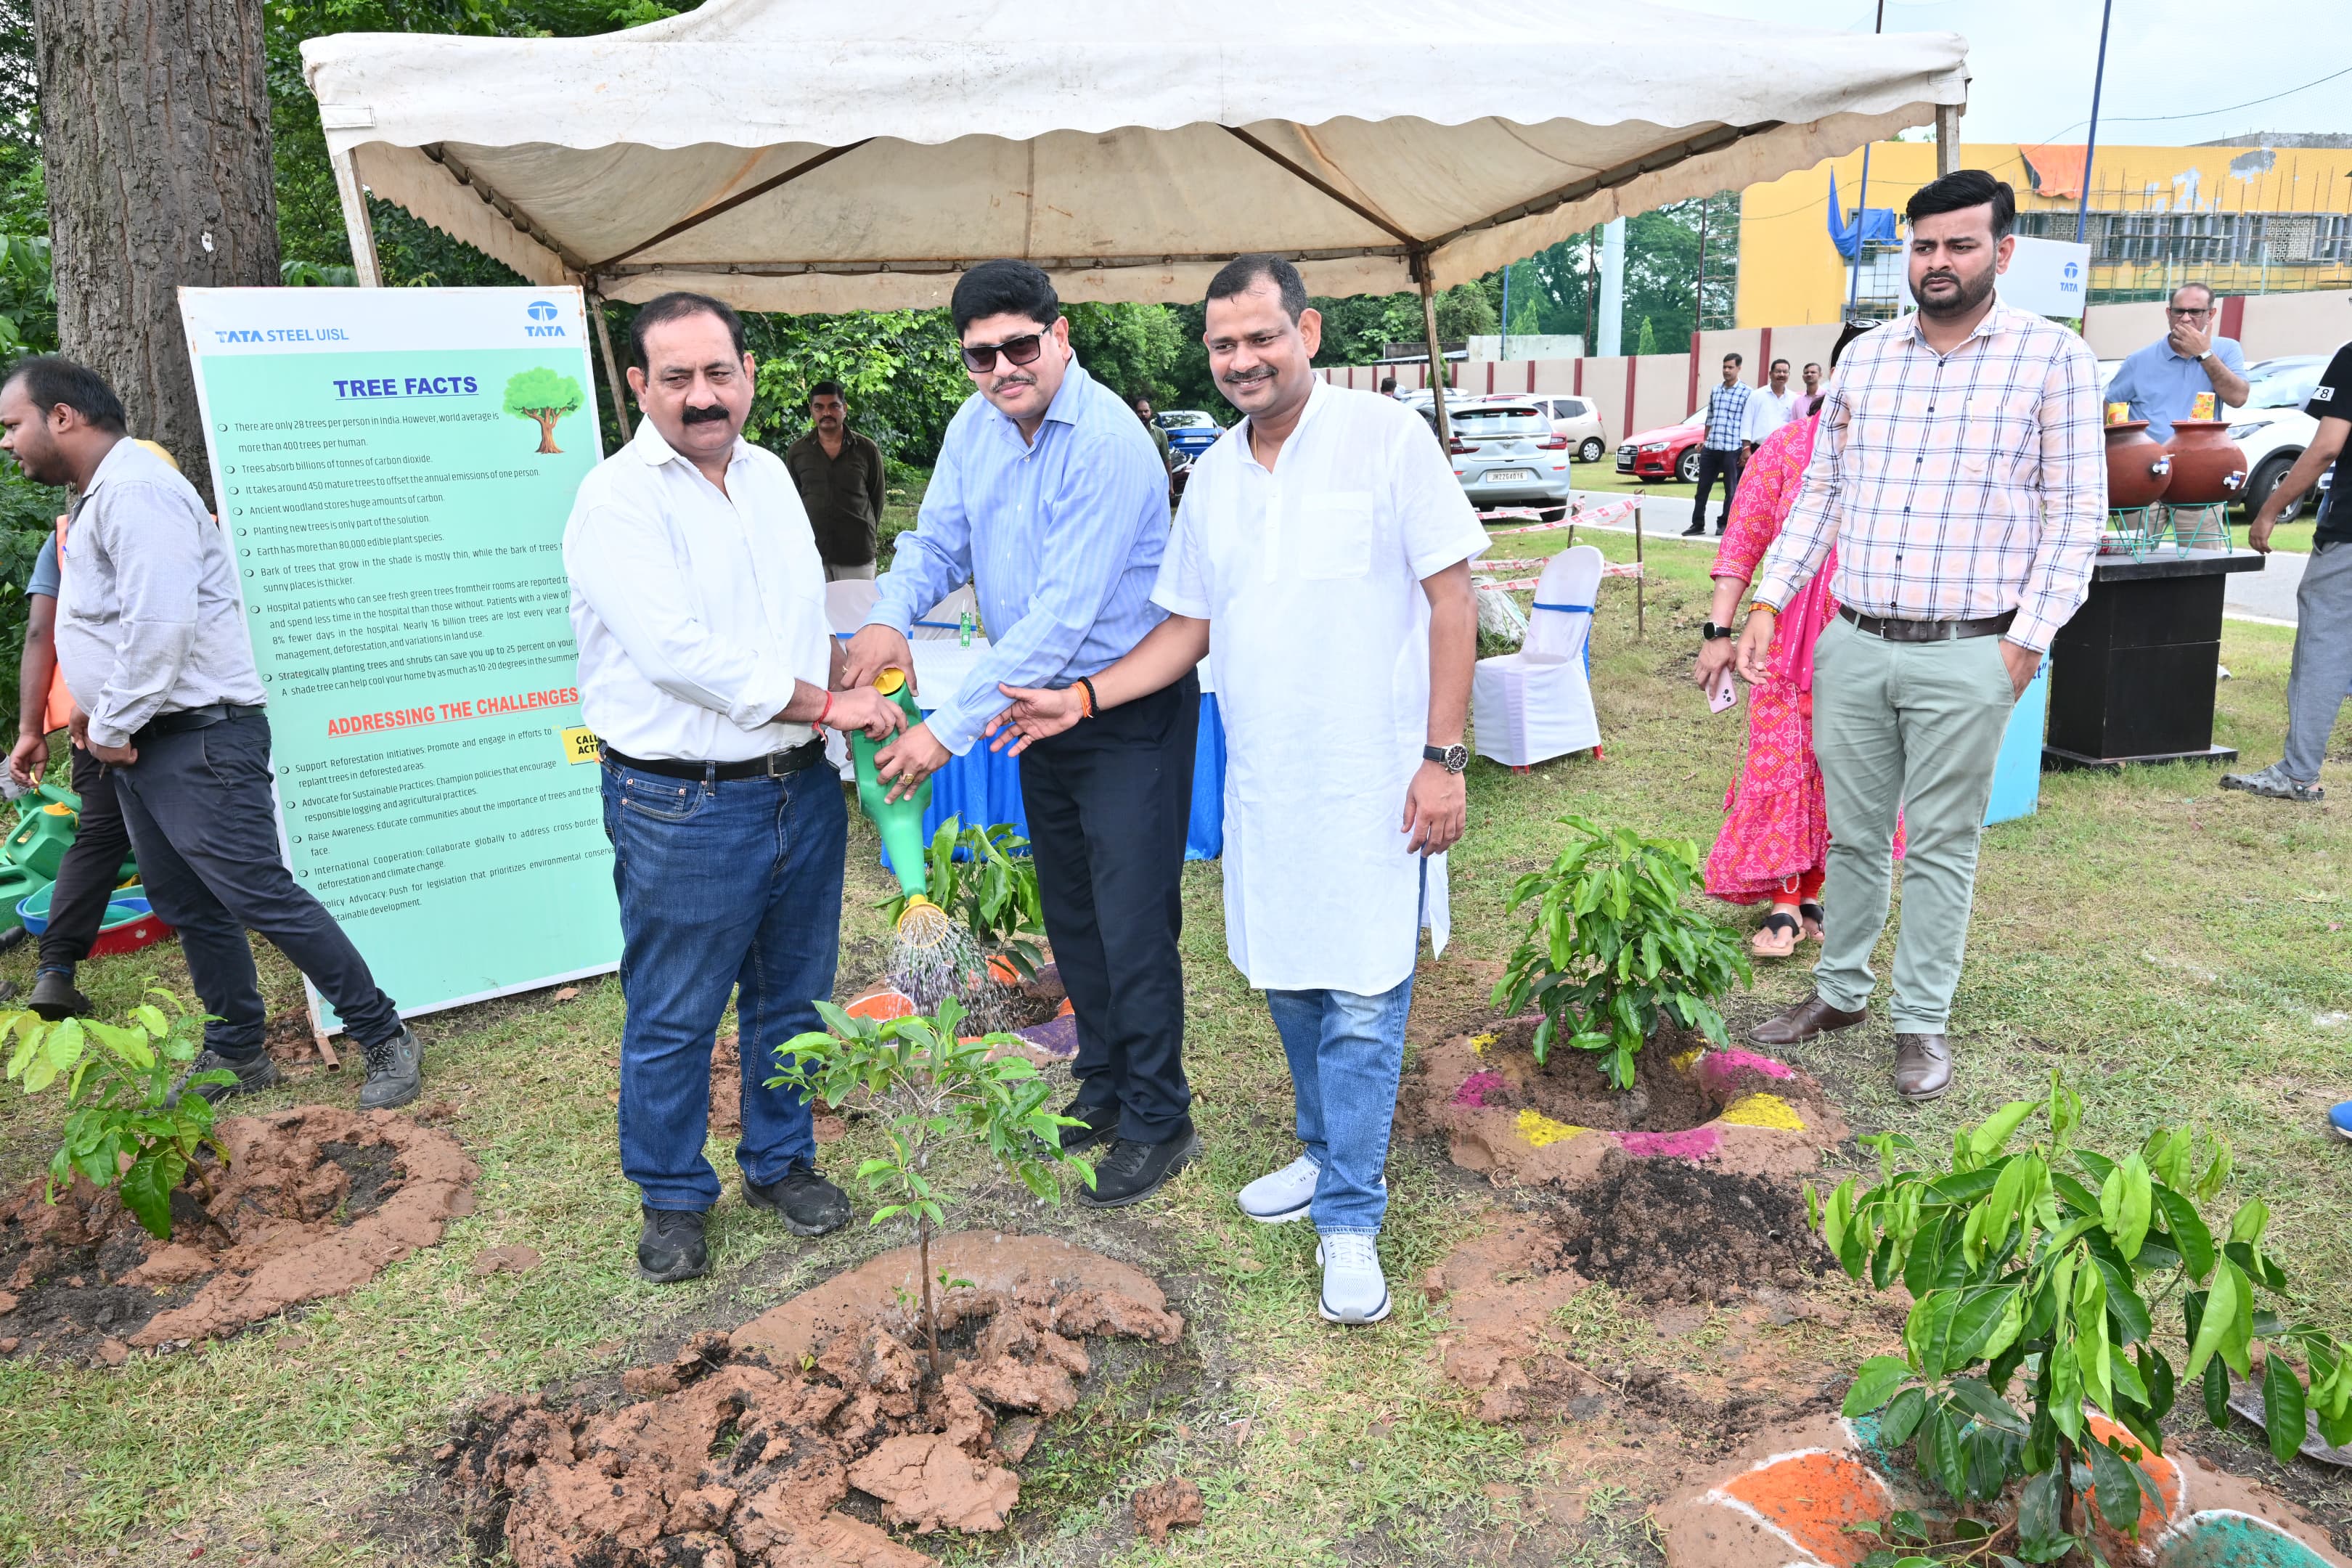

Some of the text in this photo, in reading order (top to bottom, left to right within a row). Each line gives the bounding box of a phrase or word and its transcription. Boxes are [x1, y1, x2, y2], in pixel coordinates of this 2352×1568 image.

[2060, 282, 2078, 293] TATA
[215, 328, 349, 343] TATA STEEL UISL
[524, 326, 566, 337] TATA
[333, 376, 478, 397] TREE FACTS
[234, 422, 258, 431] There
[275, 420, 293, 430] only
[293, 420, 304, 429] 28
[305, 420, 327, 428] trees
[327, 420, 341, 429] per
[342, 418, 370, 428] person
[438, 412, 460, 422] world
[461, 413, 491, 422] average
[261, 442, 282, 452] than
[282, 441, 298, 450] 400
[299, 441, 321, 449] trees
[323, 440, 336, 449] per
[241, 465, 265, 473] Trees
[266, 462, 295, 472] absorb
[295, 461, 326, 470] billions
[327, 459, 335, 468] of
[335, 459, 364, 467] tonnes
[365, 457, 373, 466] of
[375, 456, 401, 465] carbon
[245, 486, 253, 494] It
[253, 484, 277, 494] takes
[277, 482, 307, 492] around
[308, 481, 323, 490] 450
[324, 480, 354, 489] mature
[386, 475, 410, 485] offset
[409, 475, 423, 483] the
[424, 473, 451, 482] annual
[452, 471, 489, 481] emissions
[490, 470, 497, 478] of
[250, 505, 282, 515] Ancient
[282, 501, 323, 513] woodland
[324, 501, 350, 510] stores
[350, 499, 371, 508] huge
[372, 497, 407, 506] amounts
[407, 494, 415, 504] of
[253, 525, 289, 535] Planting
[290, 524, 307, 533] new
[307, 523, 330, 531] trees
[330, 520, 338, 529] is
[338, 519, 355, 529] only
[356, 518, 373, 528] part
[374, 517, 381, 526] of
[383, 517, 396, 526] the
[257, 546, 279, 556] Earth
[280, 545, 295, 554] has
[296, 544, 318, 552] more
[319, 542, 338, 551] than
[338, 539, 366, 550] 80,000
[367, 536, 391, 547] edible
[393, 536, 413, 546] plant
[263, 583, 288, 592] sunny
[290, 581, 317, 592] places
[317, 579, 324, 587] is
[389, 638, 404, 648] and
[404, 635, 444, 646] variations
[444, 633, 451, 642] in
[452, 630, 468, 640] land
[327, 687, 579, 736] ADDRESSING THE CHALLENGES
[576, 735, 598, 745] CALL
[578, 744, 599, 754] ACTI
[295, 761, 328, 772] Support
[330, 753, 384, 767] Reforestation
[427, 742, 460, 753] Promote
[462, 738, 476, 748] and
[478, 735, 506, 746] engage
[508, 732, 515, 741] in
[518, 730, 542, 739] efforts
[298, 776, 328, 788] replant
[328, 773, 349, 783] trees
[359, 764, 401, 778] deforested
[302, 795, 338, 807] Advocate
[340, 792, 351, 801] for
[352, 785, 398, 799] Sustainable
[436, 773, 473, 785] Champion
[474, 769, 502, 780] policies
[502, 766, 518, 775] that
[519, 760, 556, 772] encourage
[304, 808, 351, 822] responsible
[351, 803, 382, 815] logging
[383, 799, 397, 809] and
[399, 792, 442, 808] agricultural
[308, 831, 330, 841] Raise
[377, 818, 407, 830] Educate
[409, 809, 459, 824] communities
[460, 805, 482, 815] about
[483, 803, 495, 812] the
[497, 796, 538, 809] importance
[539, 793, 546, 802] of
[548, 791, 567, 800] trees
[568, 788, 581, 797] and
[314, 858, 369, 875] International
[425, 841, 470, 855] Collaborate
[474, 834, 505, 847] globally
[520, 827, 550, 838] address
[553, 818, 598, 832] cross-border
[317, 874, 371, 891] deforestation
[371, 870, 386, 881] and
[387, 866, 415, 877] climate
[388, 886, 408, 896] Push
[426, 875, 467, 889] legislation
[470, 870, 486, 881] that
[489, 864, 526, 878] prioritizes
[529, 852, 581, 869] environmental
[584, 844, 614, 858] conserva
[332, 909, 369, 921] stainable
